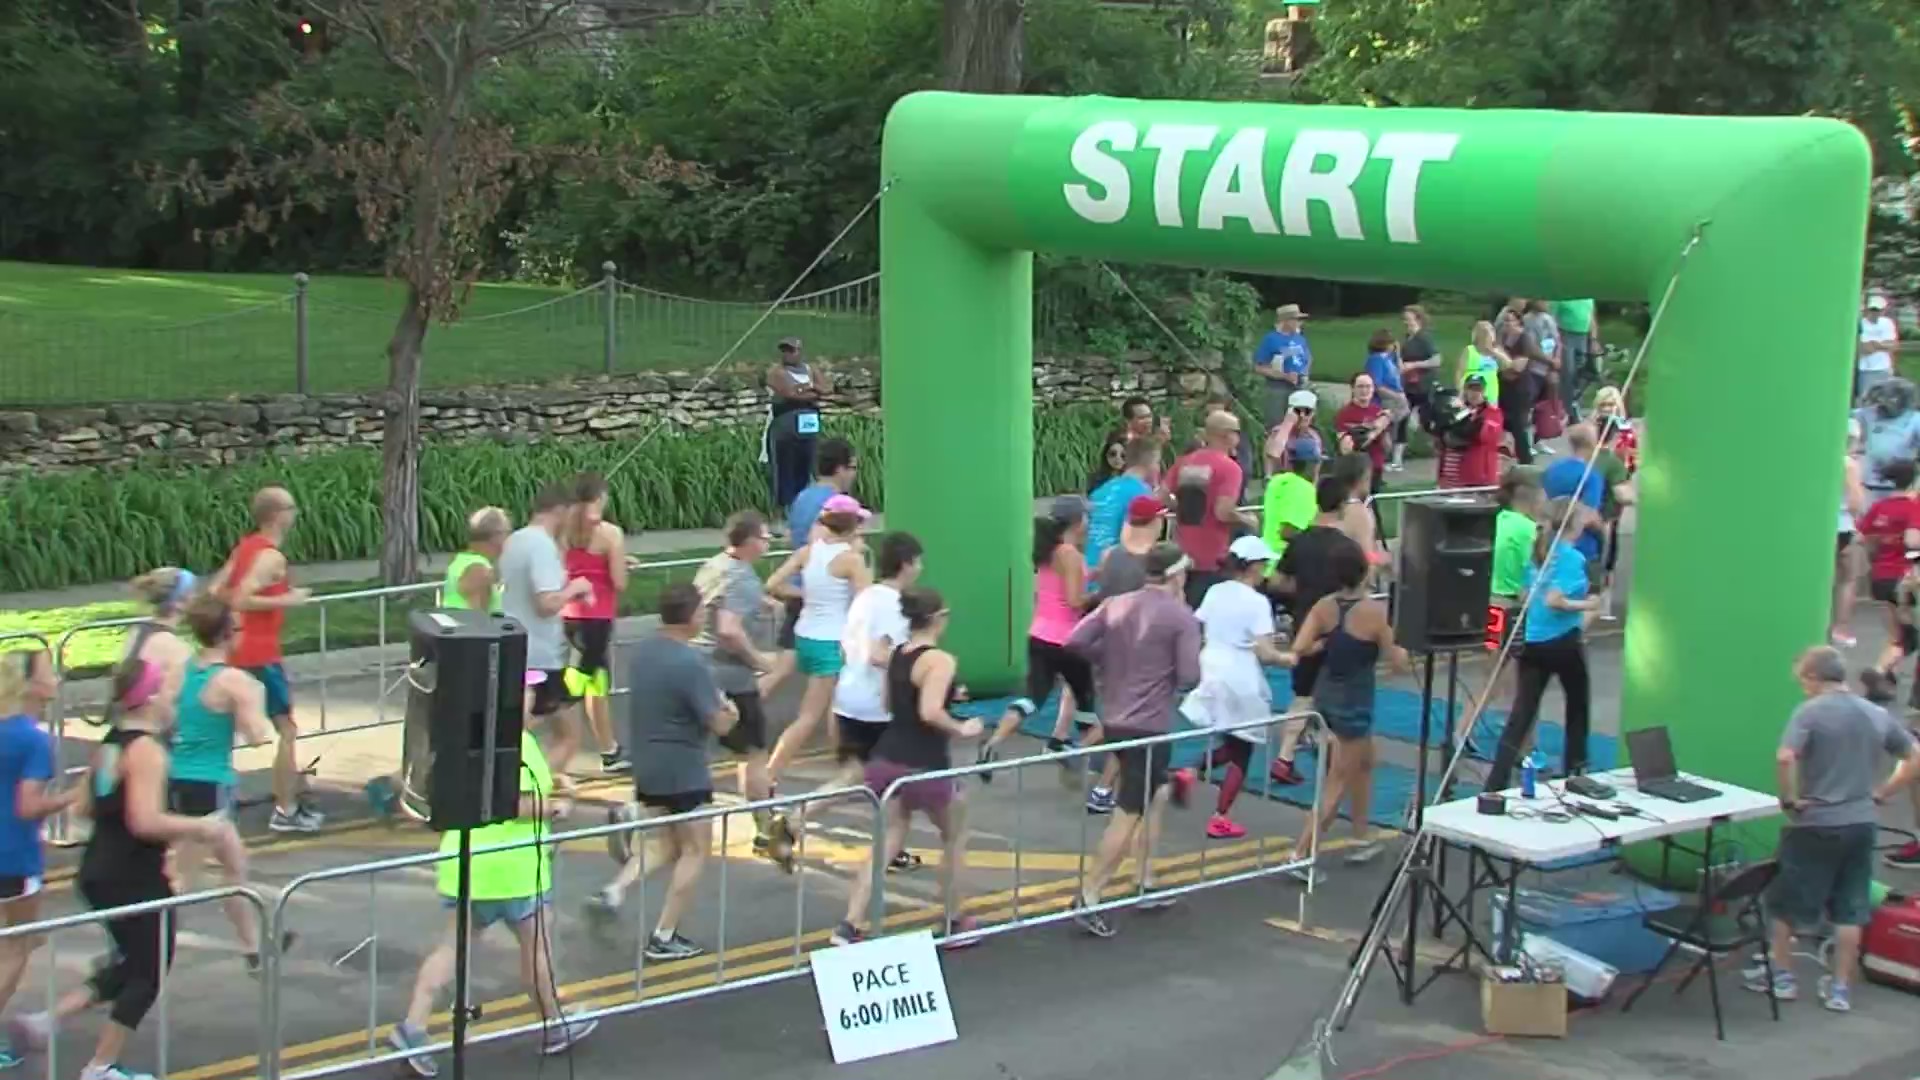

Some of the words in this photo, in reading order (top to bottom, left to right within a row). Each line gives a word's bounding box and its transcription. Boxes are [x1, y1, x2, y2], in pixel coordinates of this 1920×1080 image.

[1063, 120, 1461, 243] START
[852, 963, 911, 993] PACE
[839, 991, 937, 1030] 6:00/MILE
